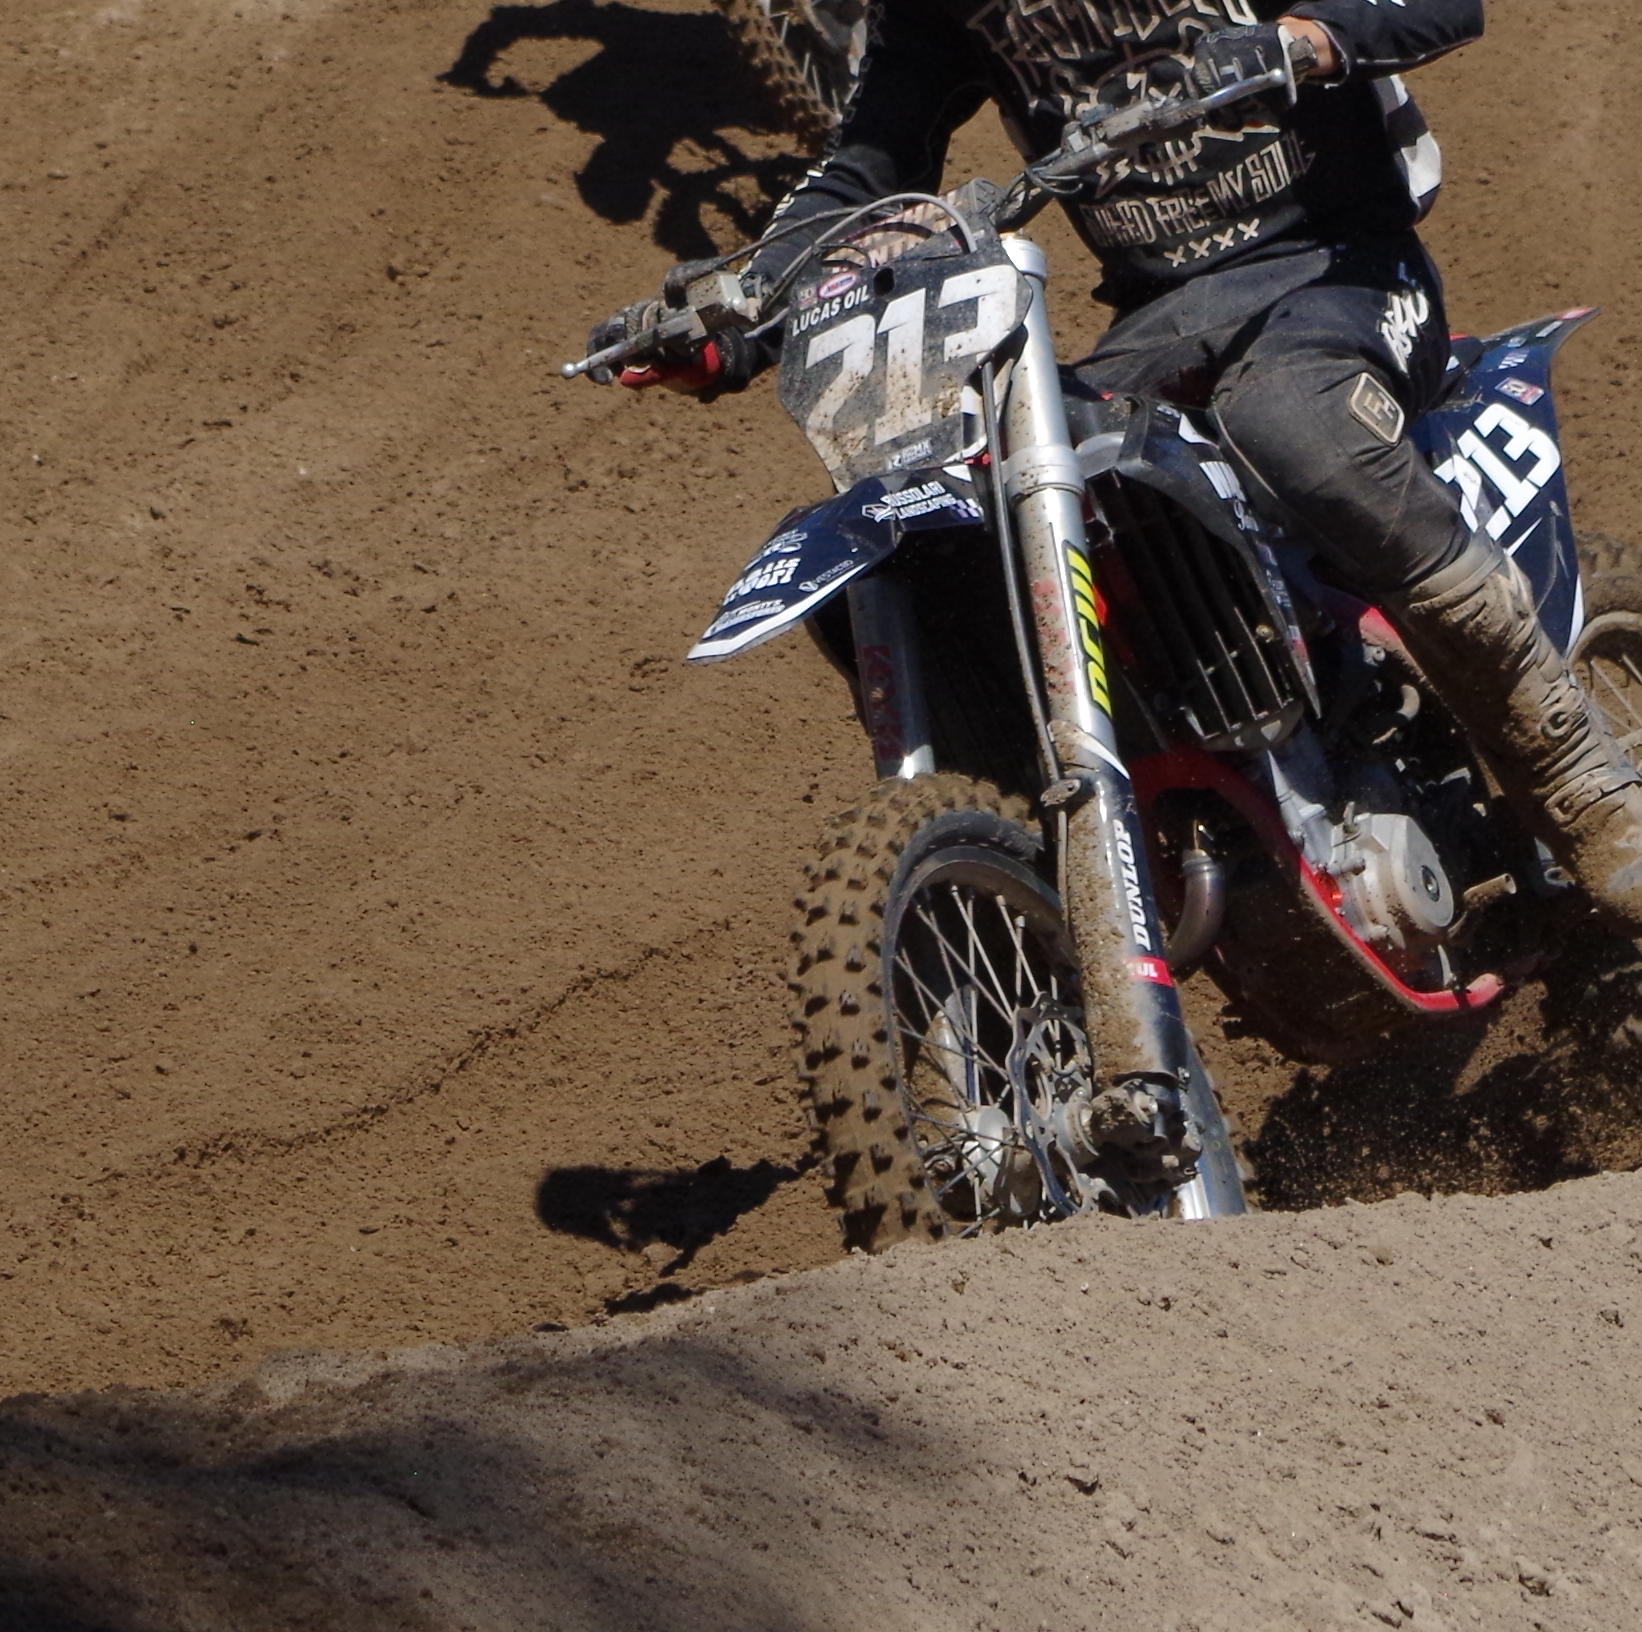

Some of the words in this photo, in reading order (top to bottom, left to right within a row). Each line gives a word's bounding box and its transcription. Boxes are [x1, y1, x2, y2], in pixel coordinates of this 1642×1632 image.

[790, 296, 842, 337] LUCAS
[843, 283, 871, 310] OIL
[806, 264, 1018, 450] 213
[1433, 402, 1562, 542] 213
[1113, 818, 1152, 950] DUNLOP
